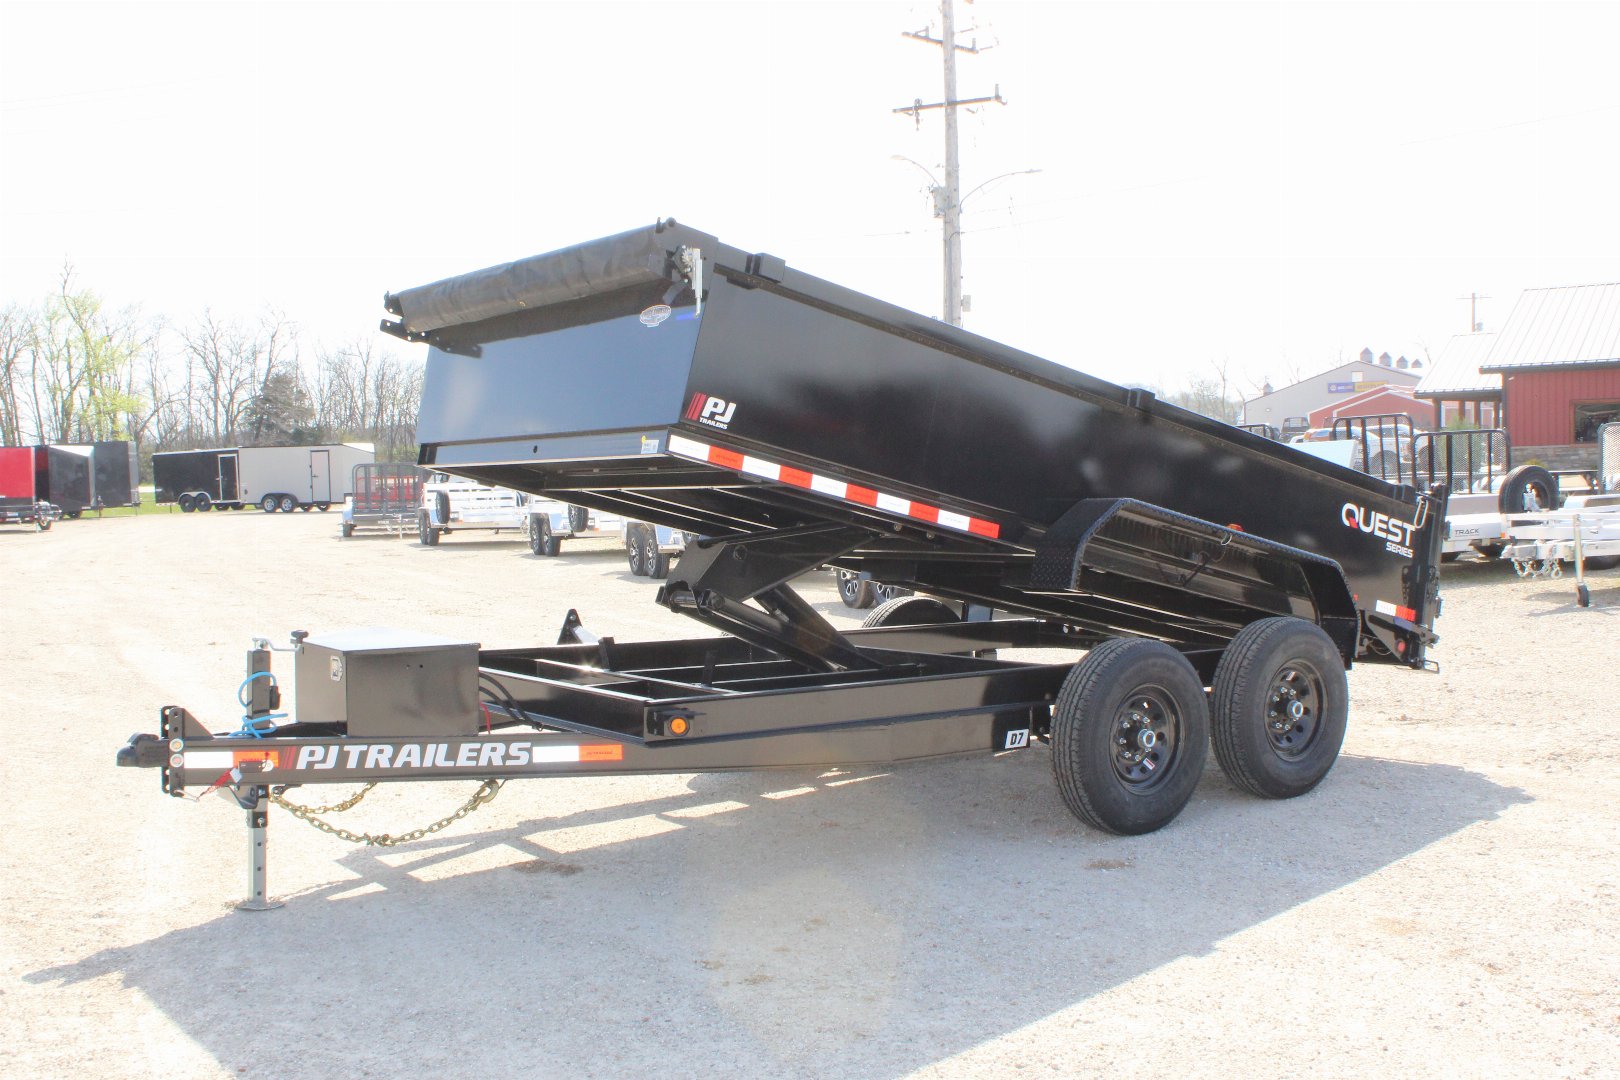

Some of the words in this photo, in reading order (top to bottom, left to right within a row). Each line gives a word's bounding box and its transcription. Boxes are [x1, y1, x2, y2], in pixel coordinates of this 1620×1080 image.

[701, 396, 737, 424] PJ
[699, 416, 729, 430] TRAILERS
[1341, 502, 1417, 547] QUEST
[1385, 541, 1414, 559] SERIES
[1010, 732, 1024, 746] D7
[296, 745, 340, 770] PJ
[343, 742, 531, 769] TRAILERS
